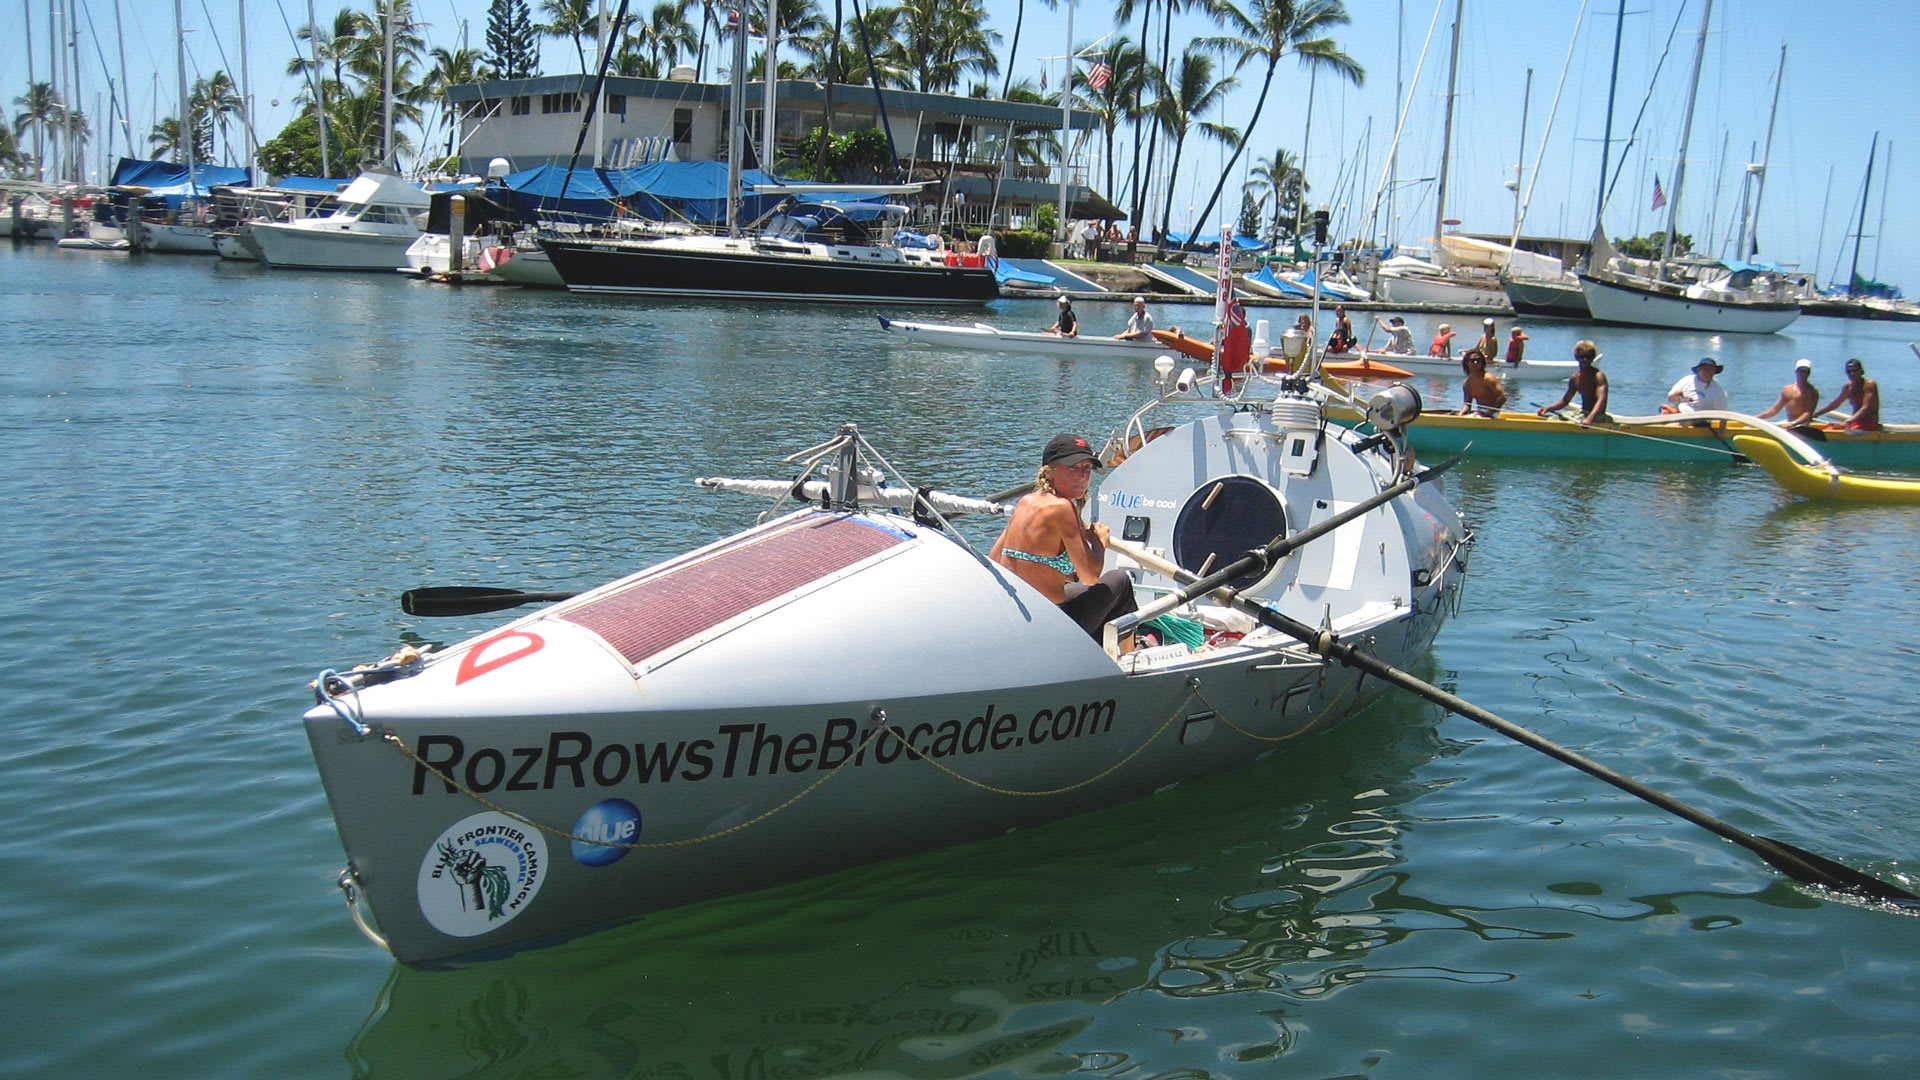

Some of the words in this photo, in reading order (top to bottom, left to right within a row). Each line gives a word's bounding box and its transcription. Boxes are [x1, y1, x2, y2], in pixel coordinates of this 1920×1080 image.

[1143, 497, 1155, 507] be
[1156, 500, 1177, 509] cool
[412, 699, 1116, 795] RozRowsTheBrocade.com
[456, 825, 525, 847] FRONTIER
[509, 842, 538, 910] CAMPAIGN
[474, 837, 520, 853] SEAWEED
